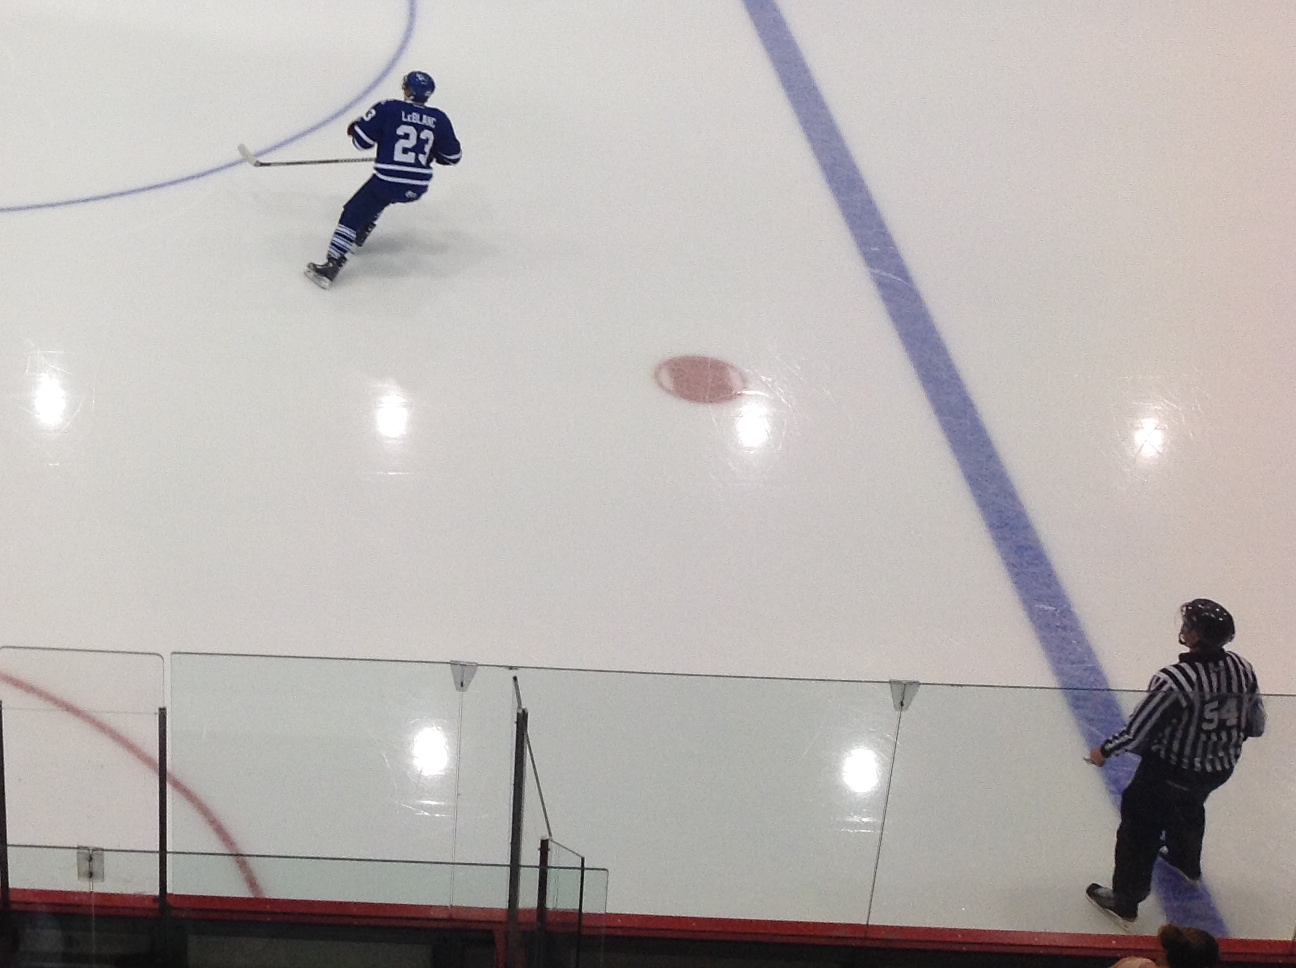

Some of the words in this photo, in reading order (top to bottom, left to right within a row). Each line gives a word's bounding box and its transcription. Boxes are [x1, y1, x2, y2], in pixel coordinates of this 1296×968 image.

[401, 111, 437, 129] LeBLANC
[393, 124, 434, 167] 23
[1201, 697, 1238, 731] 54
